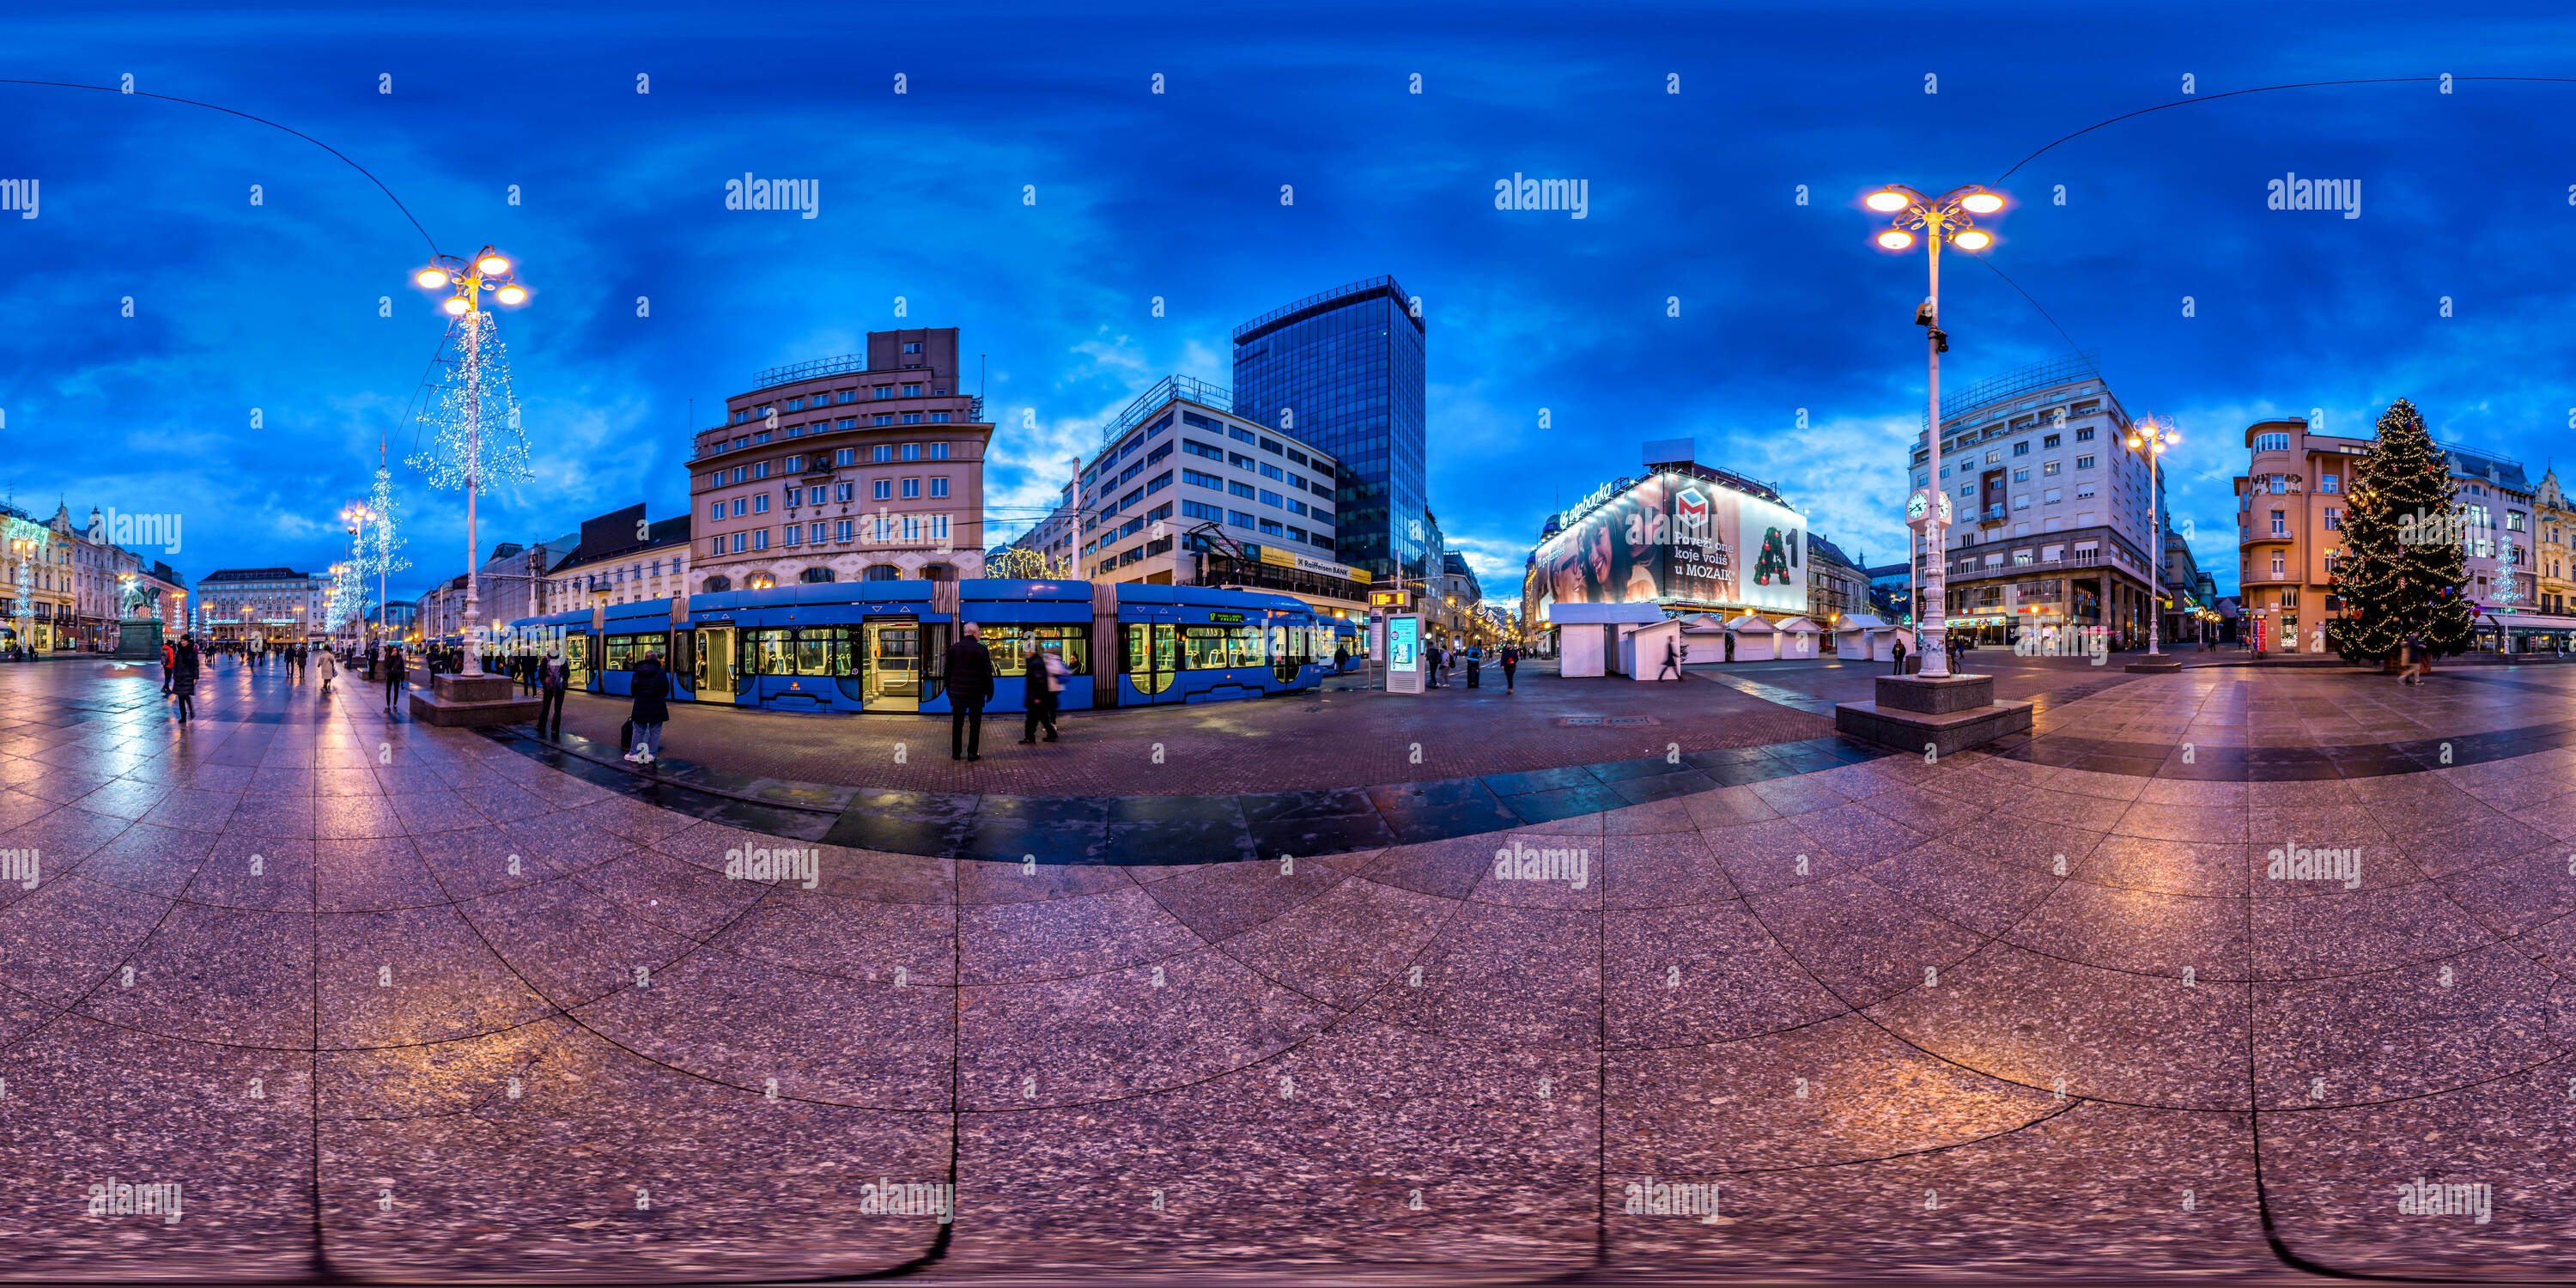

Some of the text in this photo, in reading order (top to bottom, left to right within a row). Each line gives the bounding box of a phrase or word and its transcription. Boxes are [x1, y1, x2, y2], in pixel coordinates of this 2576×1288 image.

[9, 517, 50, 547] 2021
[1674, 532, 1735, 554] Poveži one
[1674, 546, 1728, 566] koje voliš
[1753, 526, 1799, 586] A1
[1303, 560, 1333, 573] Raiffeisen
[1333, 567, 1348, 576] BANK
[1674, 566, 1683, 575] u
